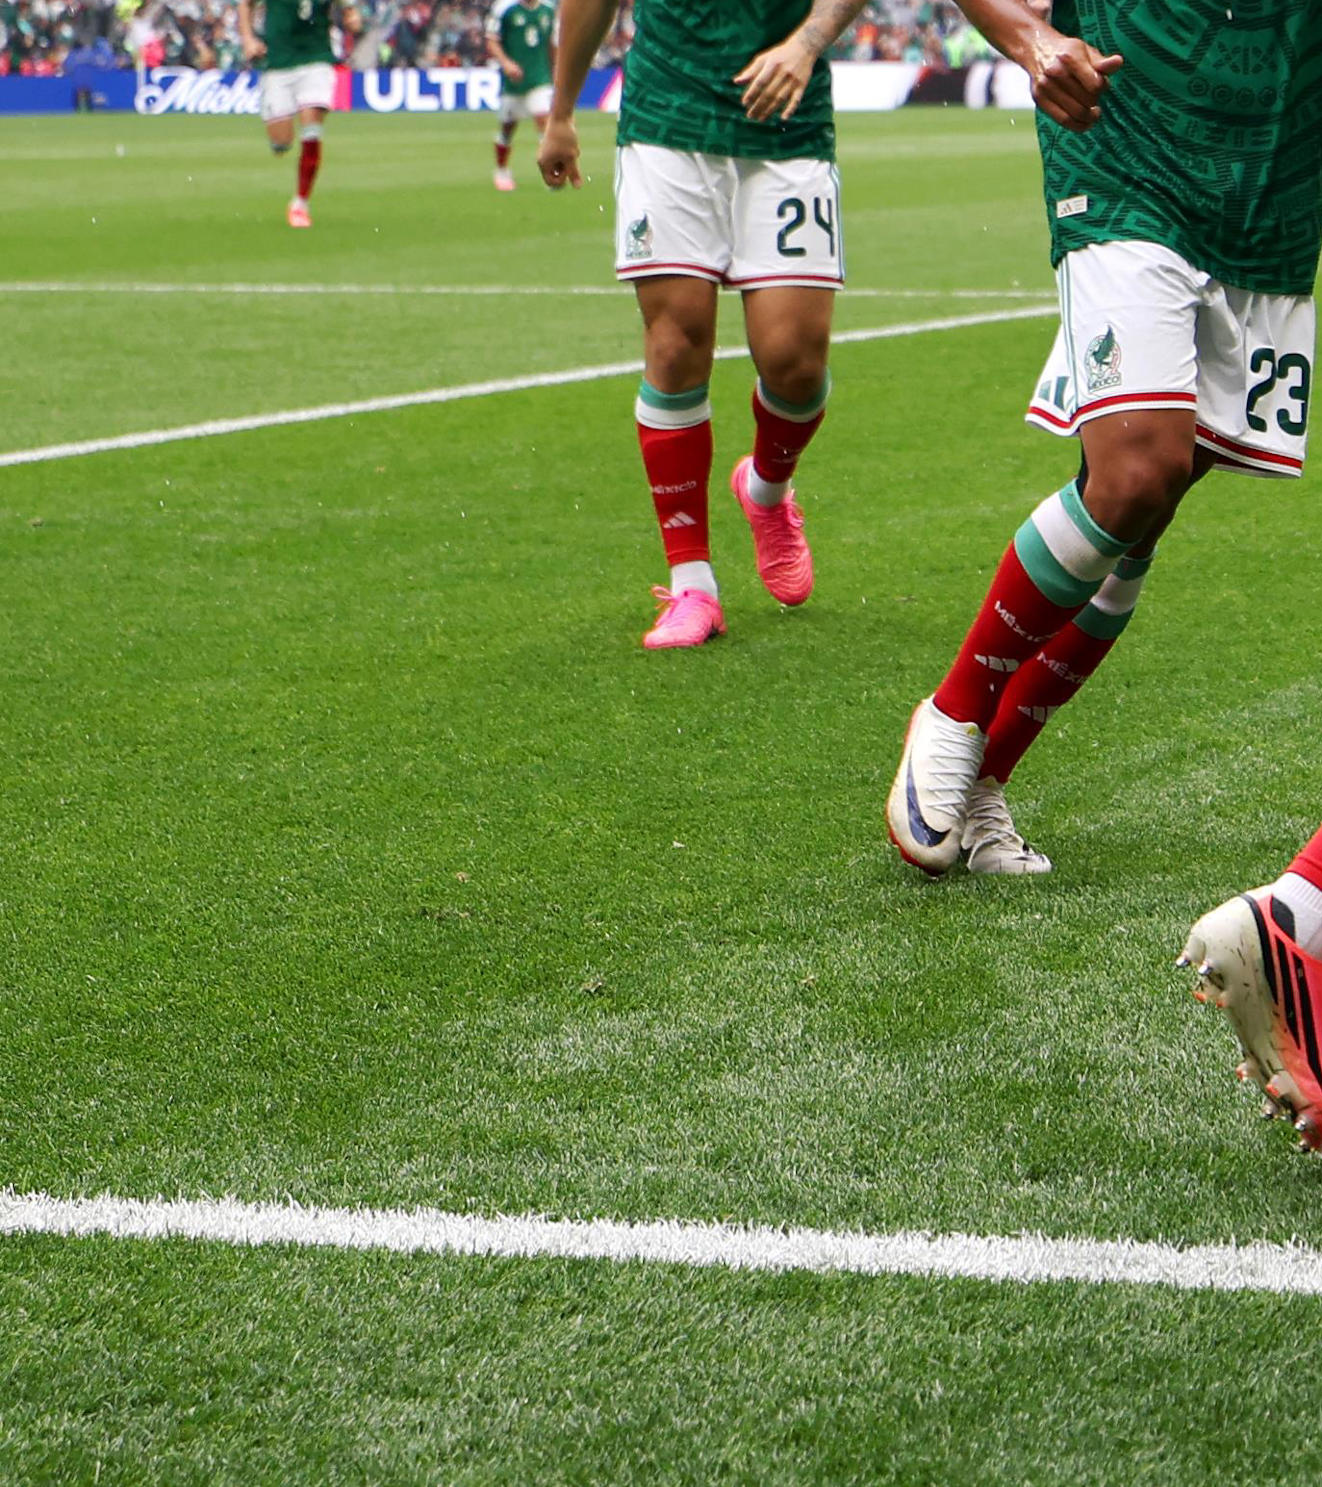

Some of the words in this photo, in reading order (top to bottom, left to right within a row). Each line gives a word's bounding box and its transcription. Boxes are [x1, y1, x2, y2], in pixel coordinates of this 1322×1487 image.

[363, 70, 500, 112] ULTR
[777, 196, 835, 257] 24
[1245, 347, 1312, 437] 23
